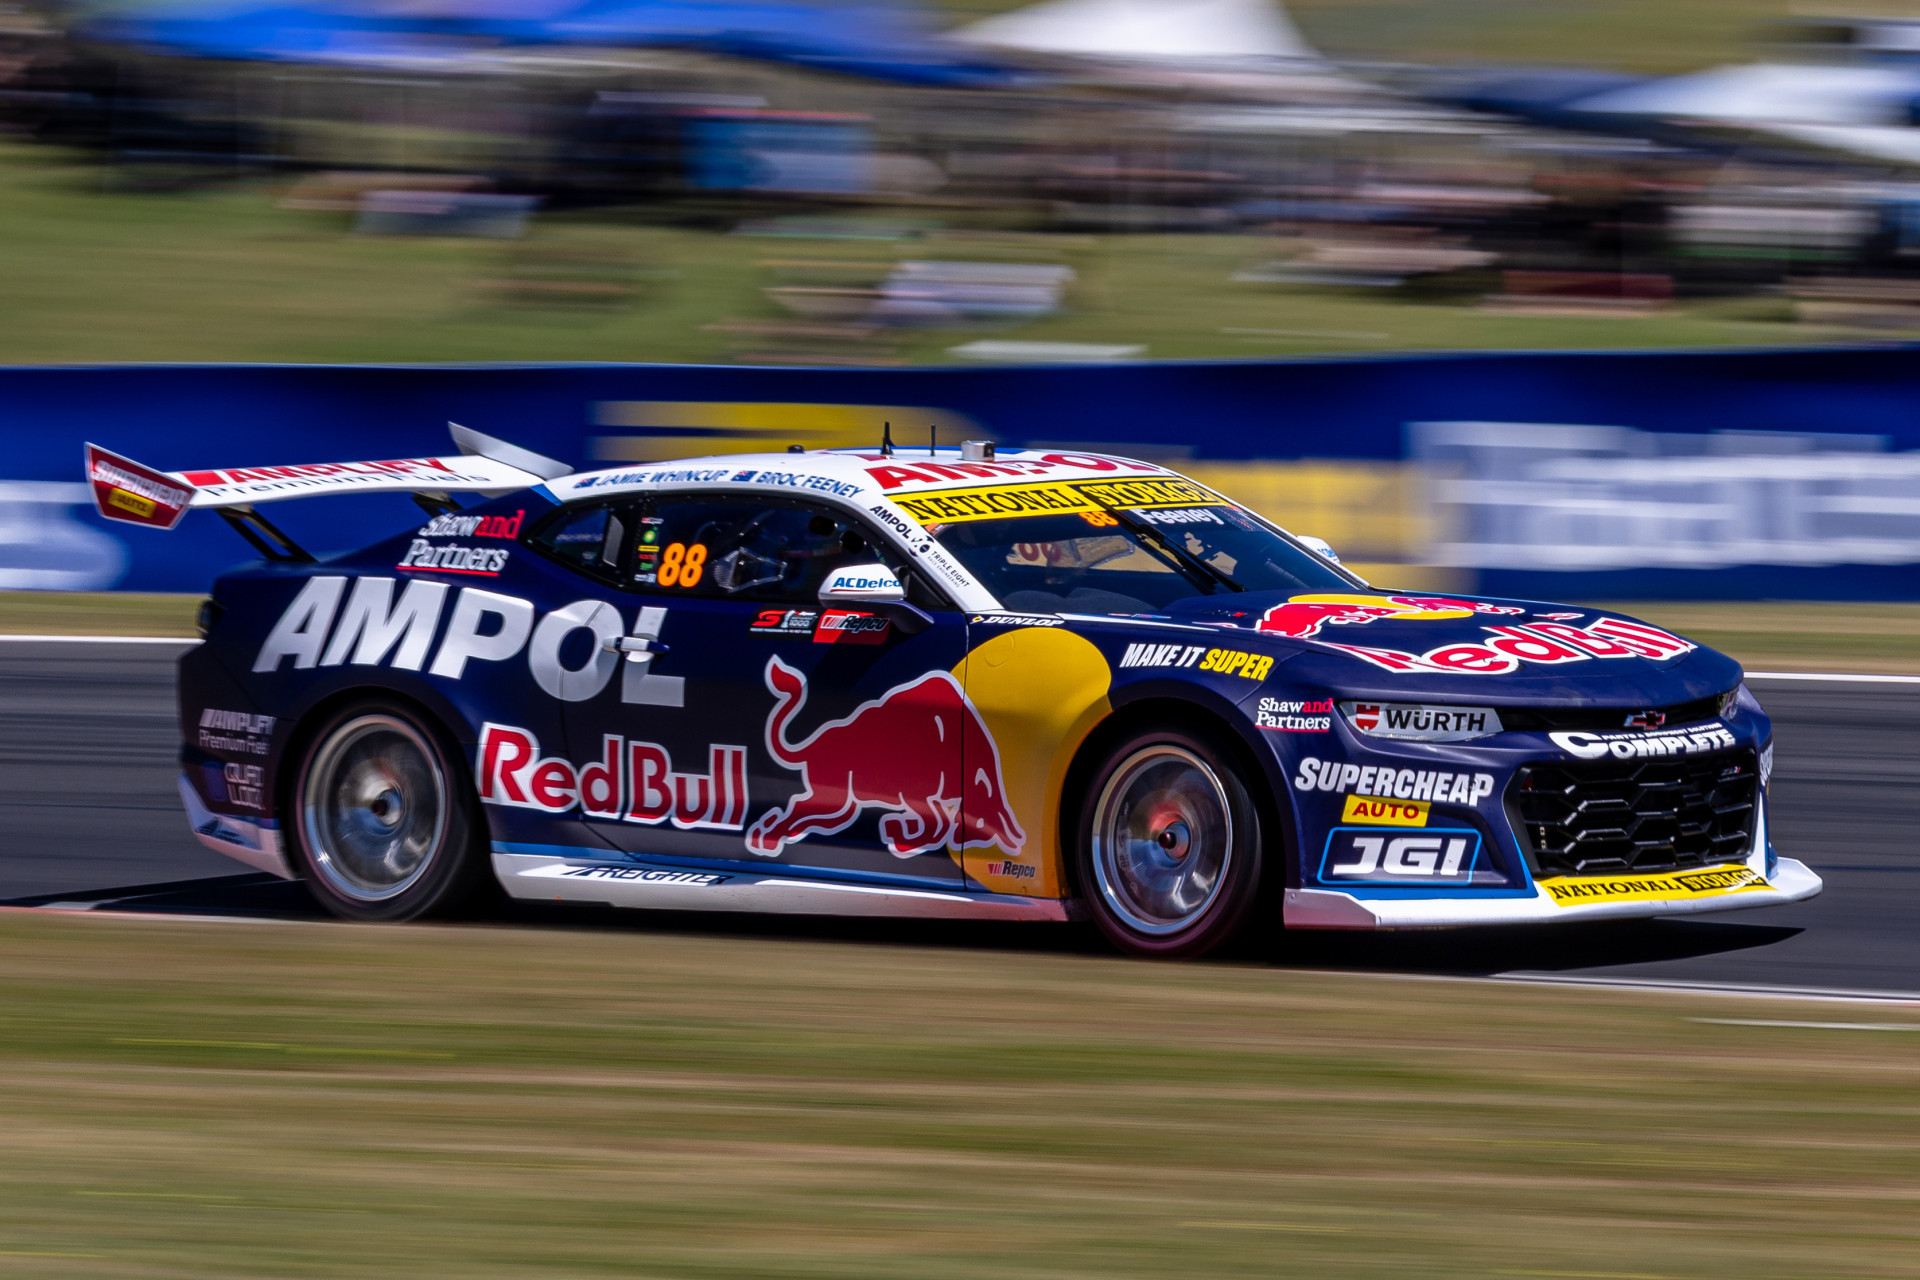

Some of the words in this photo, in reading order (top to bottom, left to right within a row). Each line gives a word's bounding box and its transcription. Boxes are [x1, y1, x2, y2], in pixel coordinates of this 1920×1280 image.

[223, 457, 456, 483] AMPLIFY
[597, 472, 646, 487] JAMIE
[650, 469, 730, 483] WHINCUP
[756, 471, 800, 487] BROC
[800, 475, 865, 498] FEENEY
[898, 488, 1090, 521] NATIONAL
[1080, 480, 1222, 507] STORAGE
[869, 505, 912, 539] AMPOL
[1078, 511, 1120, 527] 88
[1130, 508, 1225, 526] Feeney
[398, 539, 510, 572] Partners
[657, 542, 708, 587] 88
[931, 551, 952, 571] TRIPLE
[950, 569, 971, 587] EIGHT
[832, 577, 902, 589] ACDelco
[839, 614, 890, 633] Repco
[983, 616, 1065, 627] DUNLOP
[252, 575, 685, 707] AMPOL
[1119, 643, 1177, 668] MAKE
[1176, 646, 1206, 668] IT
[1199, 648, 1274, 681] SUPER
[1255, 711, 1331, 731] Partners
[1386, 709, 1486, 732] WÜRTH
[1549, 728, 1736, 760] COMPLETE
[1294, 757, 1495, 807] SUPERCHEAP
[1352, 802, 1419, 819] AUTO
[1002, 860, 1036, 879] Repco
[1332, 837, 1467, 876] JGI
[1547, 880, 1682, 900] NATIONAL
[1679, 868, 1768, 892] STORAGE
